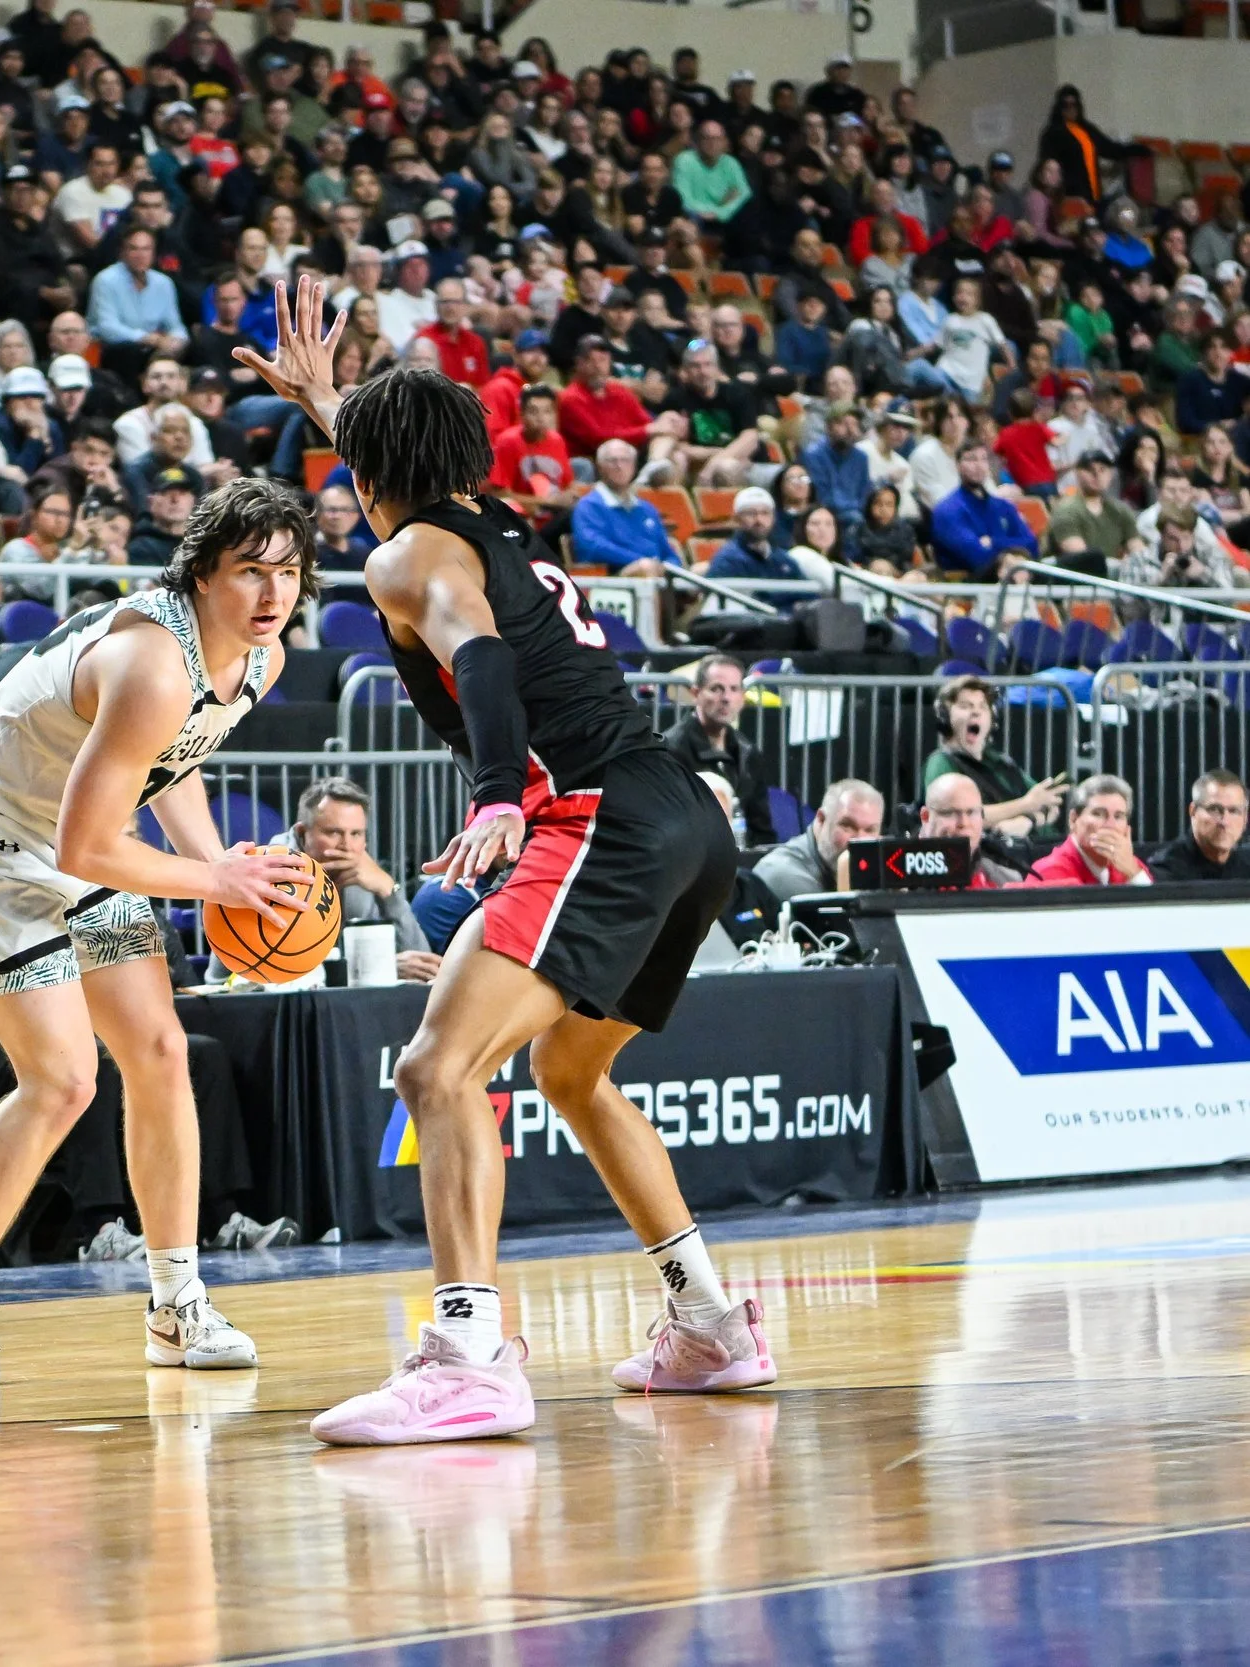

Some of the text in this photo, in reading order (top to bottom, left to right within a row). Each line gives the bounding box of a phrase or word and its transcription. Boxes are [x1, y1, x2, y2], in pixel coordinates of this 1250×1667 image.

[529, 559, 607, 649] 2
[905, 851, 949, 876] POSS.
[1057, 967, 1214, 1057] AIA
